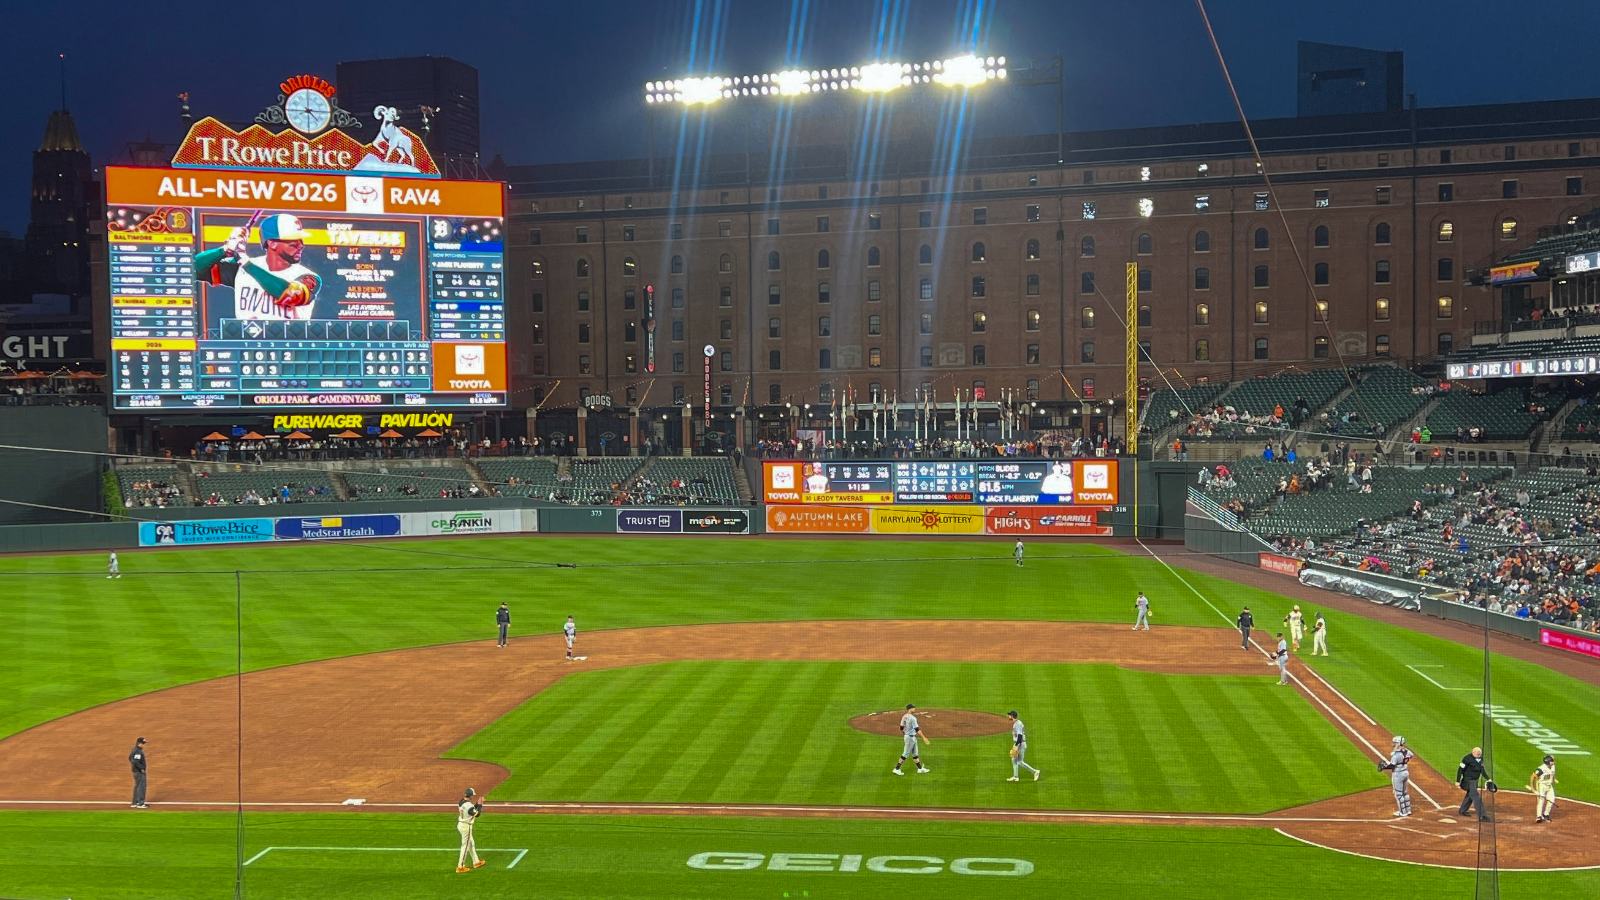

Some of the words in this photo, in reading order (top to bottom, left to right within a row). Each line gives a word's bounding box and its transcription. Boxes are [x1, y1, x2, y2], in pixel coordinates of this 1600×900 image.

[280, 75, 336, 98] ORIOLES
[196, 137, 219, 162] T.
[221, 138, 290, 164] Rowe
[291, 141, 352, 167] Price
[158, 176, 275, 200] ALL-NEW
[281, 181, 337, 203] 2026
[390, 187, 441, 206] RAV4
[2, 336, 69, 358] GHT
[243, 352, 249, 360] 1
[255, 352, 264, 360] 0
[270, 352, 275, 360] 1
[284, 352, 291, 360] 2
[366, 352, 373, 361] 4
[378, 352, 386, 361] 6
[392, 352, 398, 361] 1
[407, 352, 414, 361] 3
[419, 352, 427, 361] 2
[242, 366, 250, 374] 0
[256, 366, 264, 374] 0
[269, 366, 277, 374] 3
[366, 366, 374, 374] 3
[379, 366, 386, 374] 4
[391, 366, 399, 374] 0
[407, 366, 415, 374] 4
[420, 366, 426, 374] 1
[449, 380, 491, 389] TOYOTA
[254, 395, 286, 404] ORIOLE
[287, 395, 310, 404] PARK
[319, 395, 353, 403] CAMDEN
[353, 395, 381, 403] YARDS
[586, 394, 611, 407] BOOGS
[273, 414, 363, 429] PUREWAGER
[380, 413, 453, 427] PAVILION
[1078, 493, 1113, 501] TOYOTA
[626, 517, 656, 525] TRUIST
[789, 512, 833, 521] AUTUMN
[837, 512, 863, 521] LAKE
[939, 516, 972, 524] LOTTERY
[432, 520, 449, 528] CP
[450, 518, 492, 528] RANKIN
[994, 517, 1031, 530] HIGH'S
[192, 524, 226, 536] Rowe
[227, 522, 259, 534] Price
[302, 529, 342, 538] MedStar
[343, 528, 374, 536] Health
[686, 851, 1035, 876] GEICO
